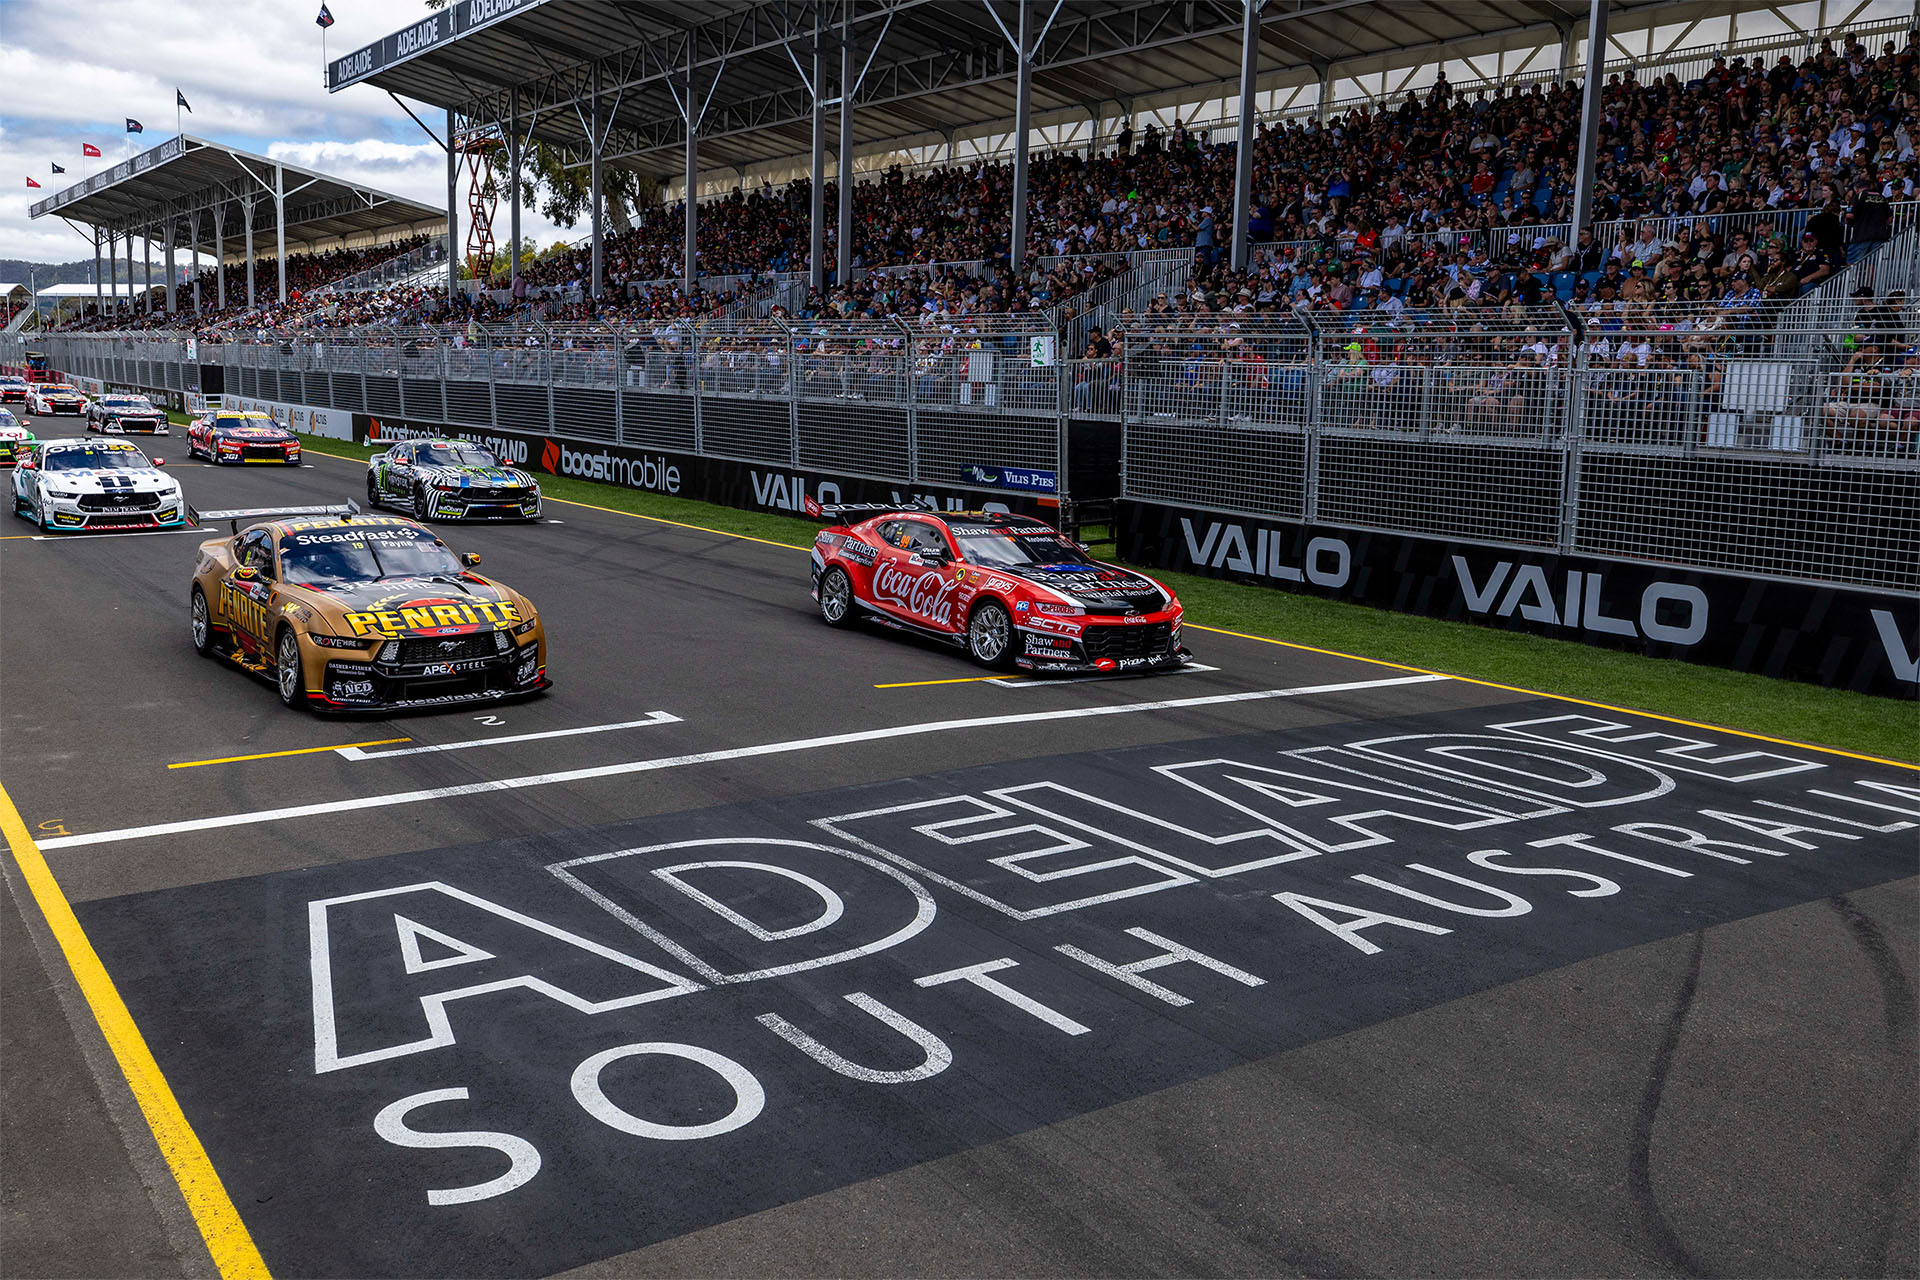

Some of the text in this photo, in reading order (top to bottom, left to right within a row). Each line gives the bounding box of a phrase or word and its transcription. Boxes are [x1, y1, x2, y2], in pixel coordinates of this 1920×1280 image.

[397, 17, 439, 57] ADELAIDE
[337, 48, 372, 83] ADELAIDE
[561, 444, 681, 494] boostmobile
[1031, 473, 1054, 488] PIES
[295, 529, 398, 546] Steadfast
[381, 540, 413, 548] Payne
[843, 535, 879, 559] Partners
[900, 535, 911, 548] 99
[1180, 517, 1351, 588] VAILO
[985, 576, 1014, 592] grays
[218, 579, 270, 643] PENRITE
[1451, 555, 1709, 646] VAILO
[343, 600, 523, 637] PENRITE
[1028, 616, 1082, 634] SCTR
[1024, 643, 1071, 659] Partners
[422, 660, 487, 676] APEX STEEL
[344, 682, 373, 695] NED
[473, 715, 506, 726] 2
[308, 713, 1827, 1075] ADELAIDE
[373, 927, 1269, 1206] SOUTH
